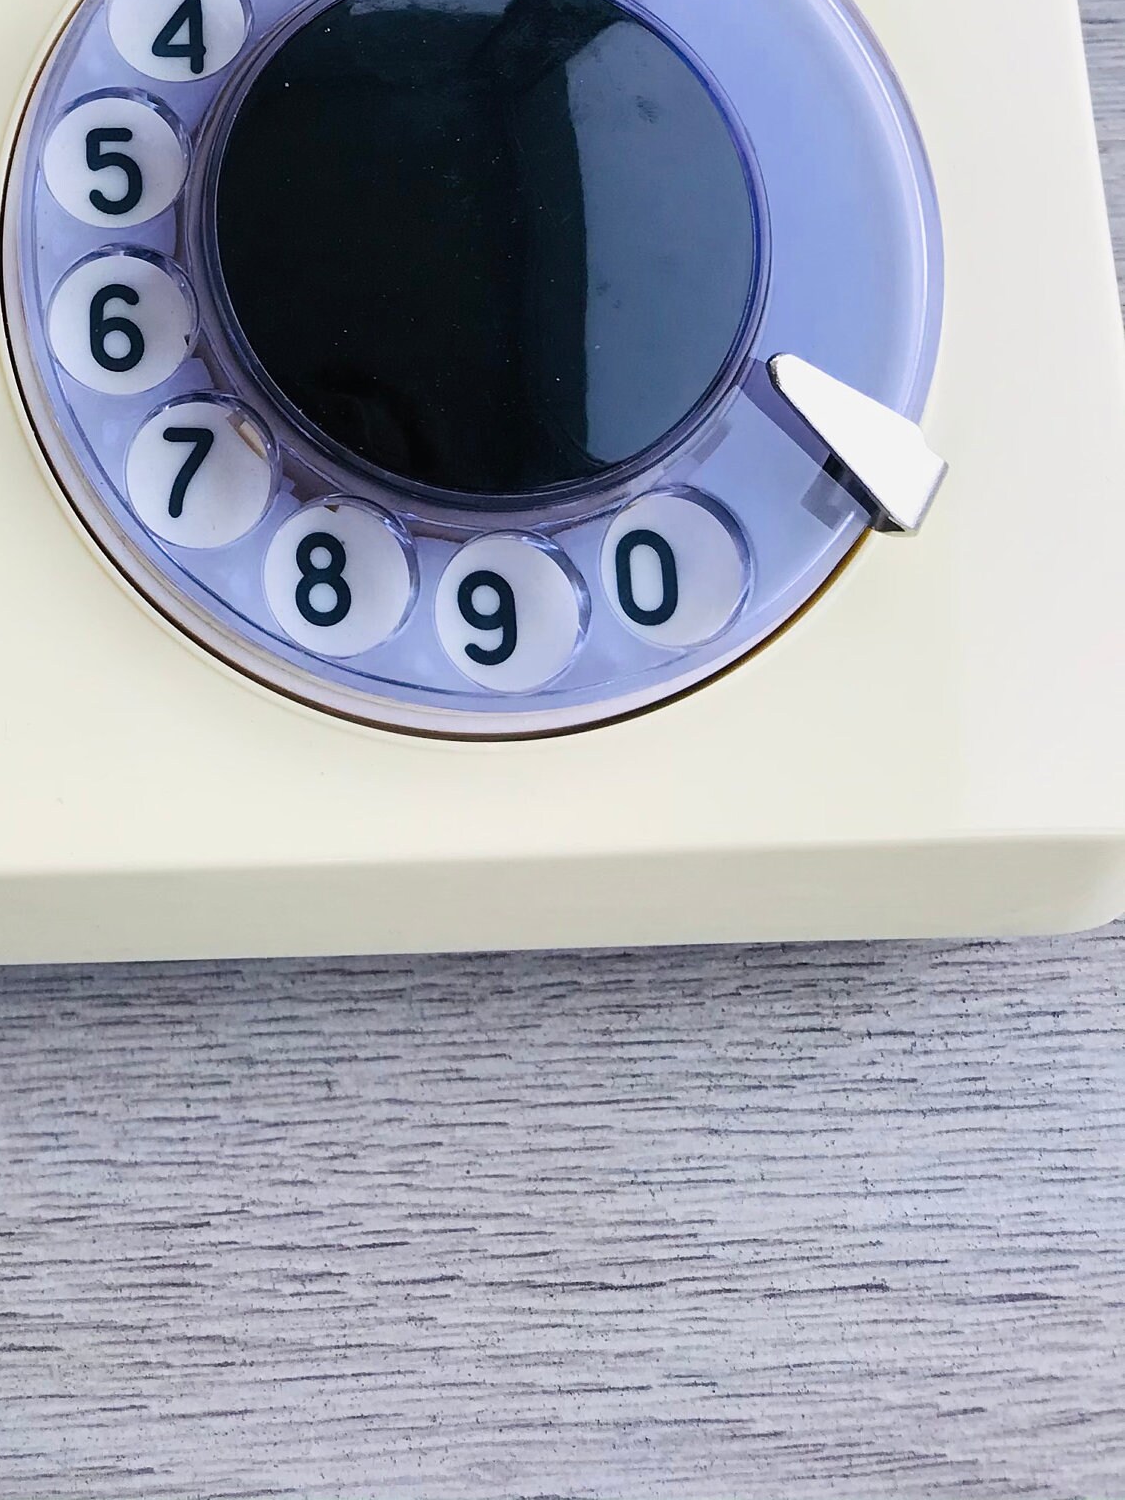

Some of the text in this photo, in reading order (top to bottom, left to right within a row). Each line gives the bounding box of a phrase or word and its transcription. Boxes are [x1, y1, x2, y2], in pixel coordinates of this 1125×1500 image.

[85, 127, 143, 215] 5
[89, 283, 145, 373] 6
[162, 426, 215, 519] 7
[294, 531, 352, 628] 8
[456, 569, 518, 666] 9
[614, 528, 678, 627] 0
